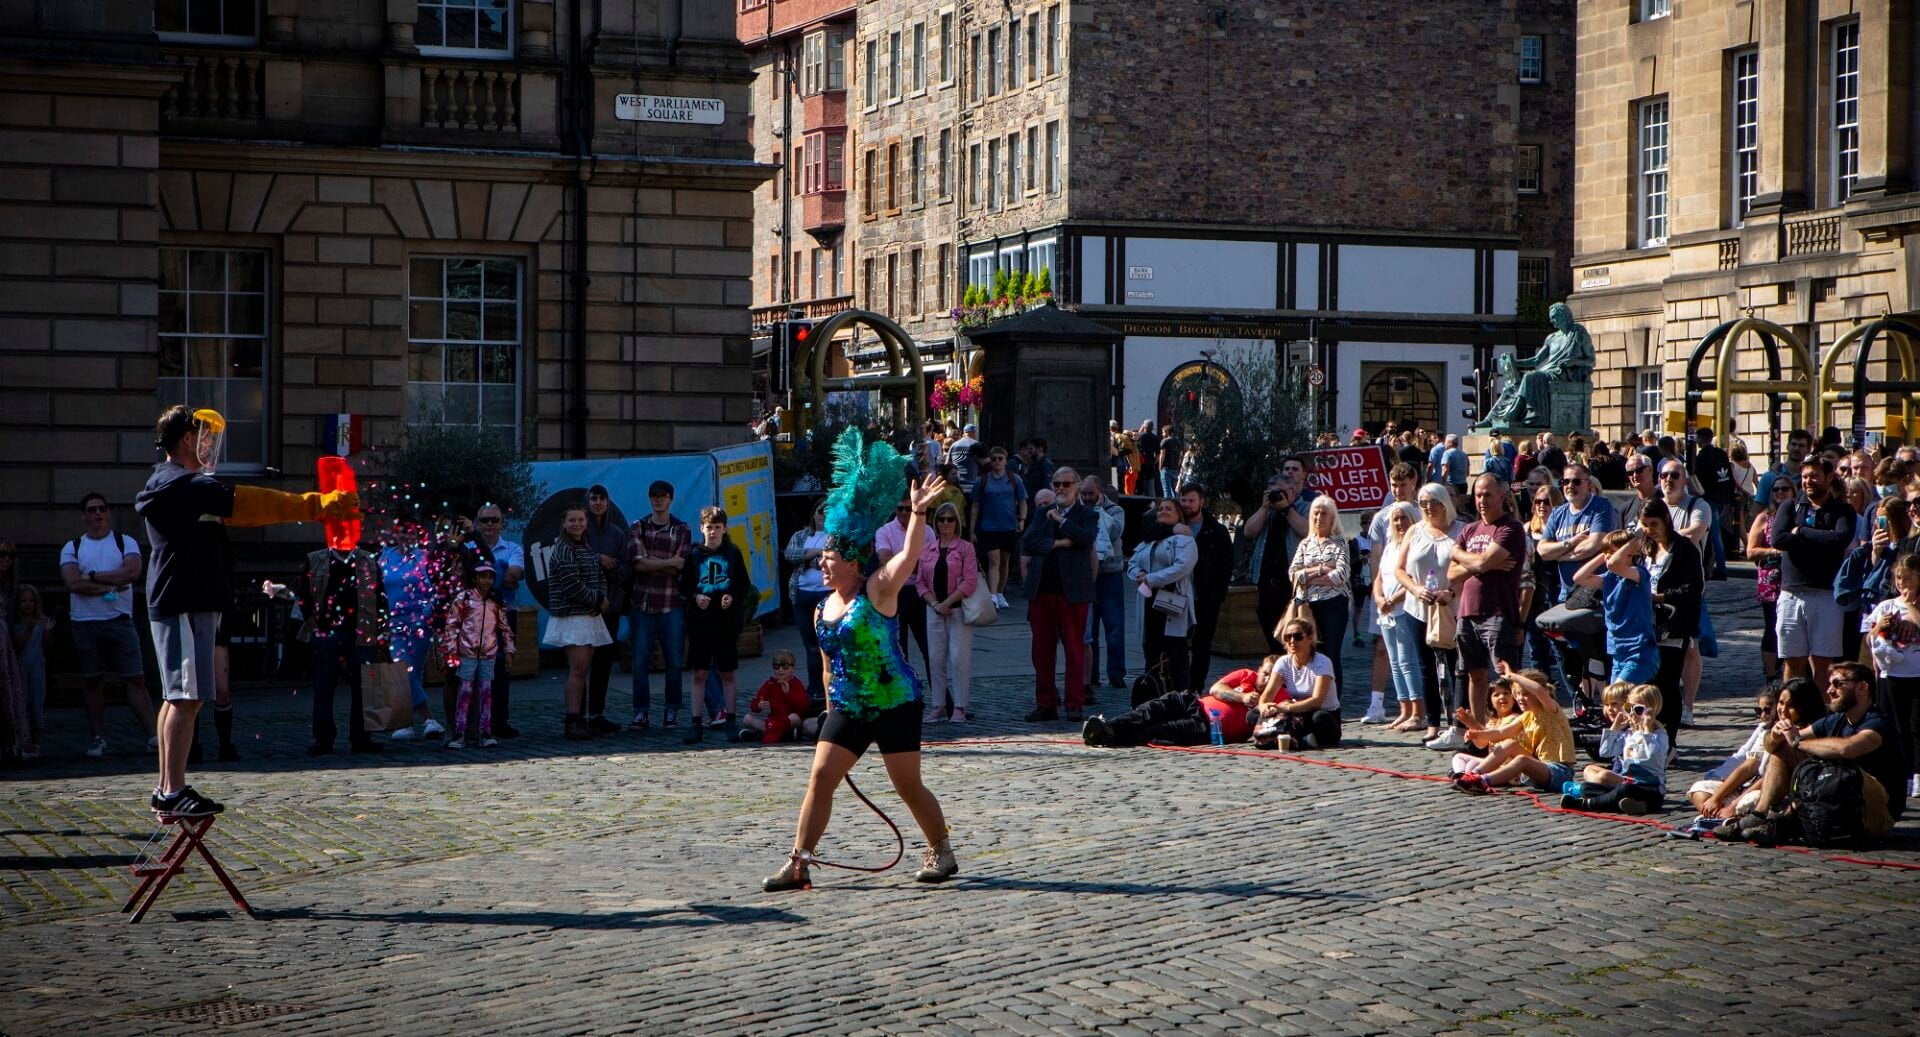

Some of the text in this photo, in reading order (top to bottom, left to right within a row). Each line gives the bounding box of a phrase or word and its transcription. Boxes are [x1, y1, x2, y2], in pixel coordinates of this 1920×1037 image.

[619, 96, 721, 111] WEST PARLIAMENT
[647, 109, 693, 120] SQUARE
[1124, 323, 1171, 334] DEACON
[1237, 326, 1281, 337] TAVERN
[1312, 373, 1323, 381] 20
[1314, 453, 1365, 470] ROAD
[1307, 468, 1379, 487] ON LEFT
